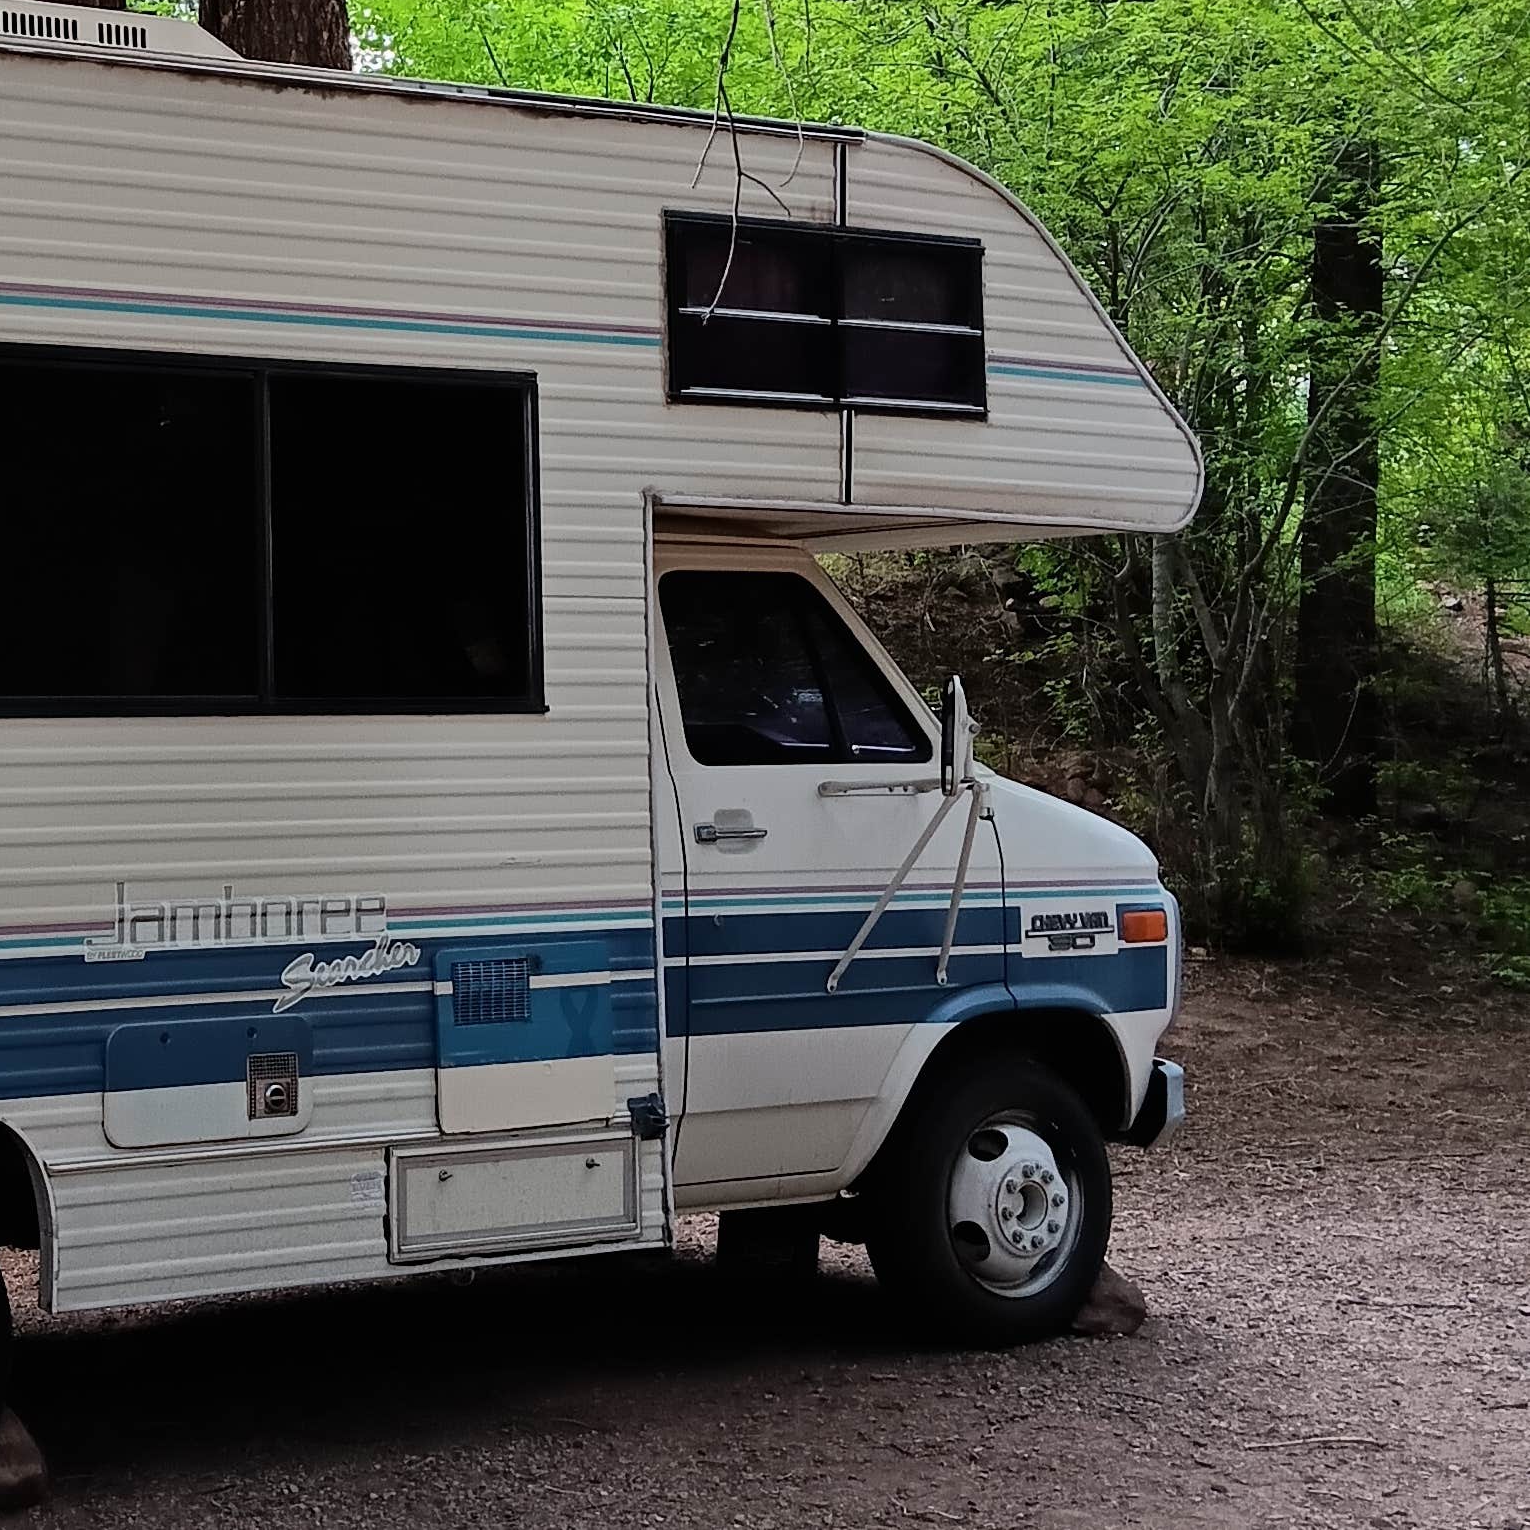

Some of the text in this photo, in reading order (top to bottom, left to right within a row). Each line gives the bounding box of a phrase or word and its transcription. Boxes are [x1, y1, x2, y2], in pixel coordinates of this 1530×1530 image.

[84, 880, 386, 945] Jamboree
[1031, 911, 1109, 931] CHEVY VAN
[273, 933, 421, 1013] Searcher
